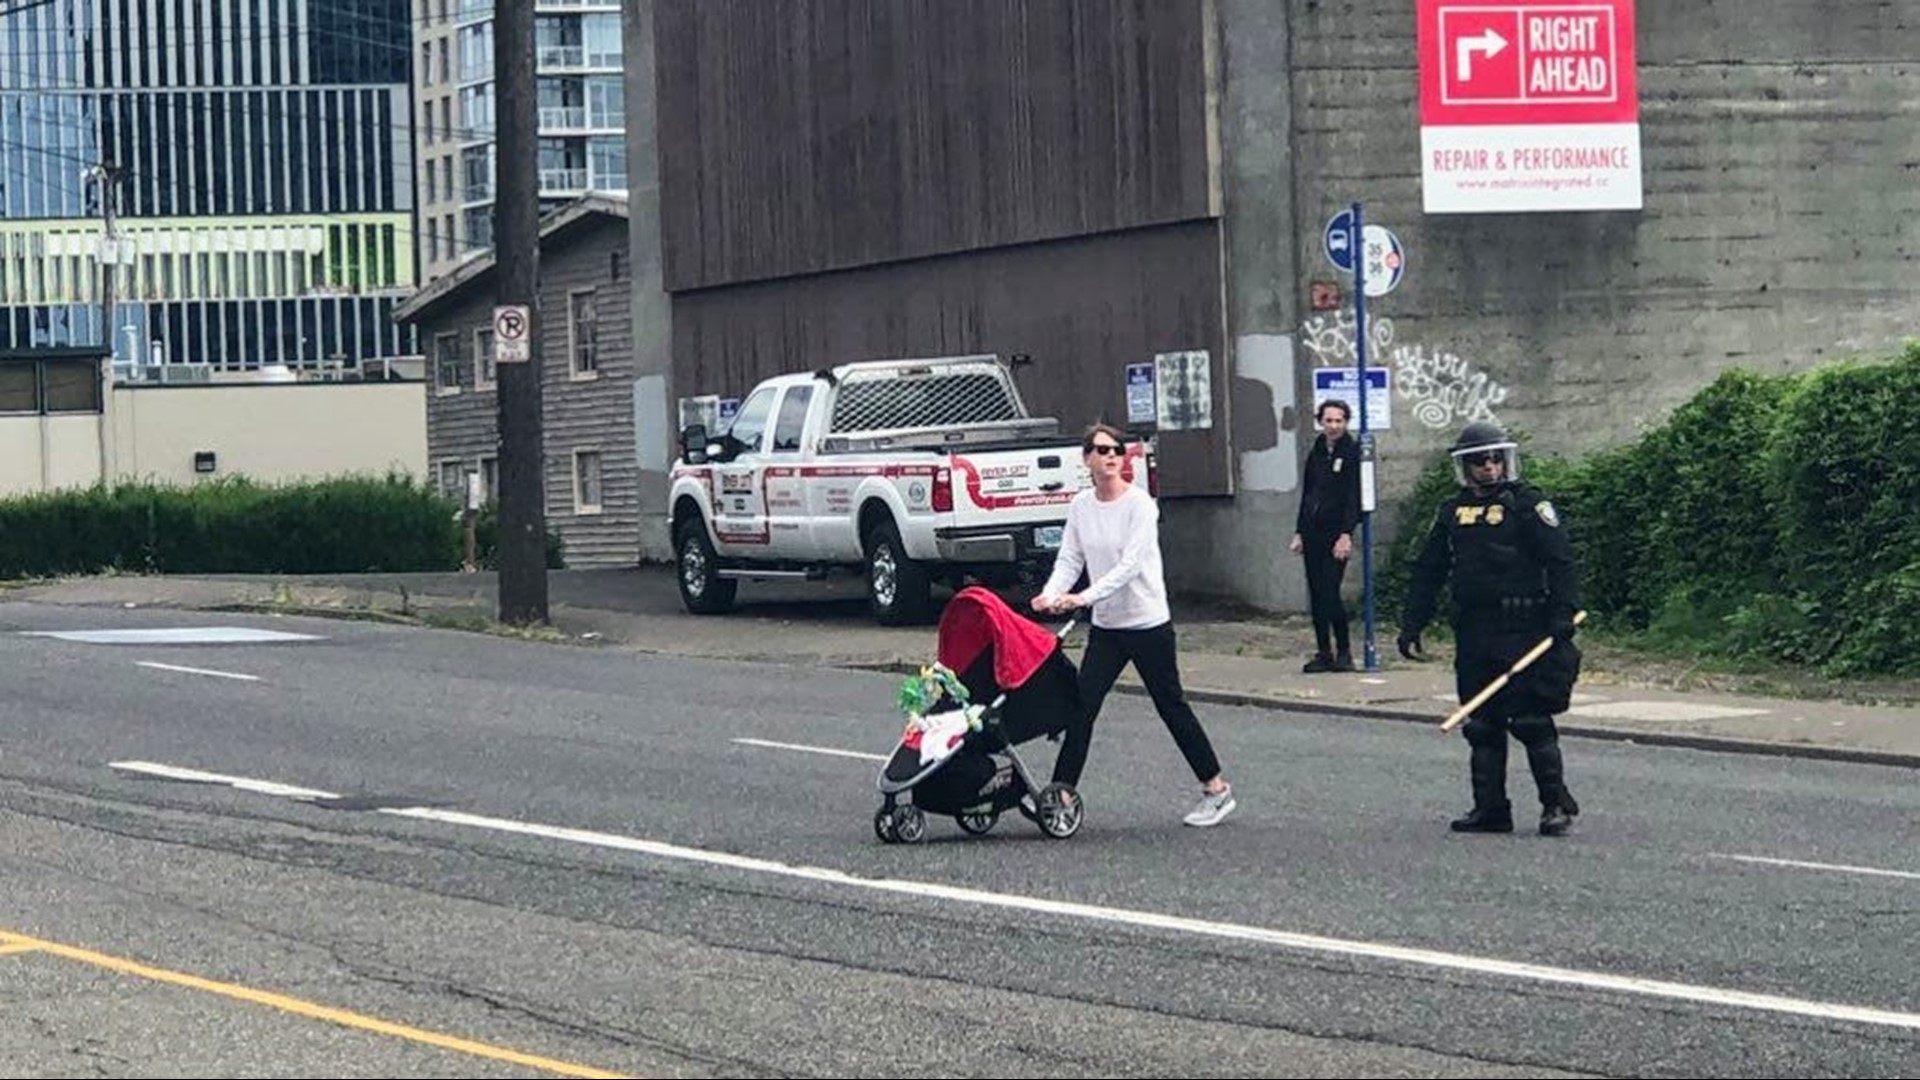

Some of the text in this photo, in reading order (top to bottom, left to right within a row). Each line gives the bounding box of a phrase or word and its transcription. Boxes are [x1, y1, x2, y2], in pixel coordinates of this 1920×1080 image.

[1529, 16, 1599, 52] RIGHT
[1530, 56, 1607, 92] AHEAD
[1433, 146, 1630, 171] REPAIR & PERFORMANCE
[1329, 380, 1373, 389] PARKIG
